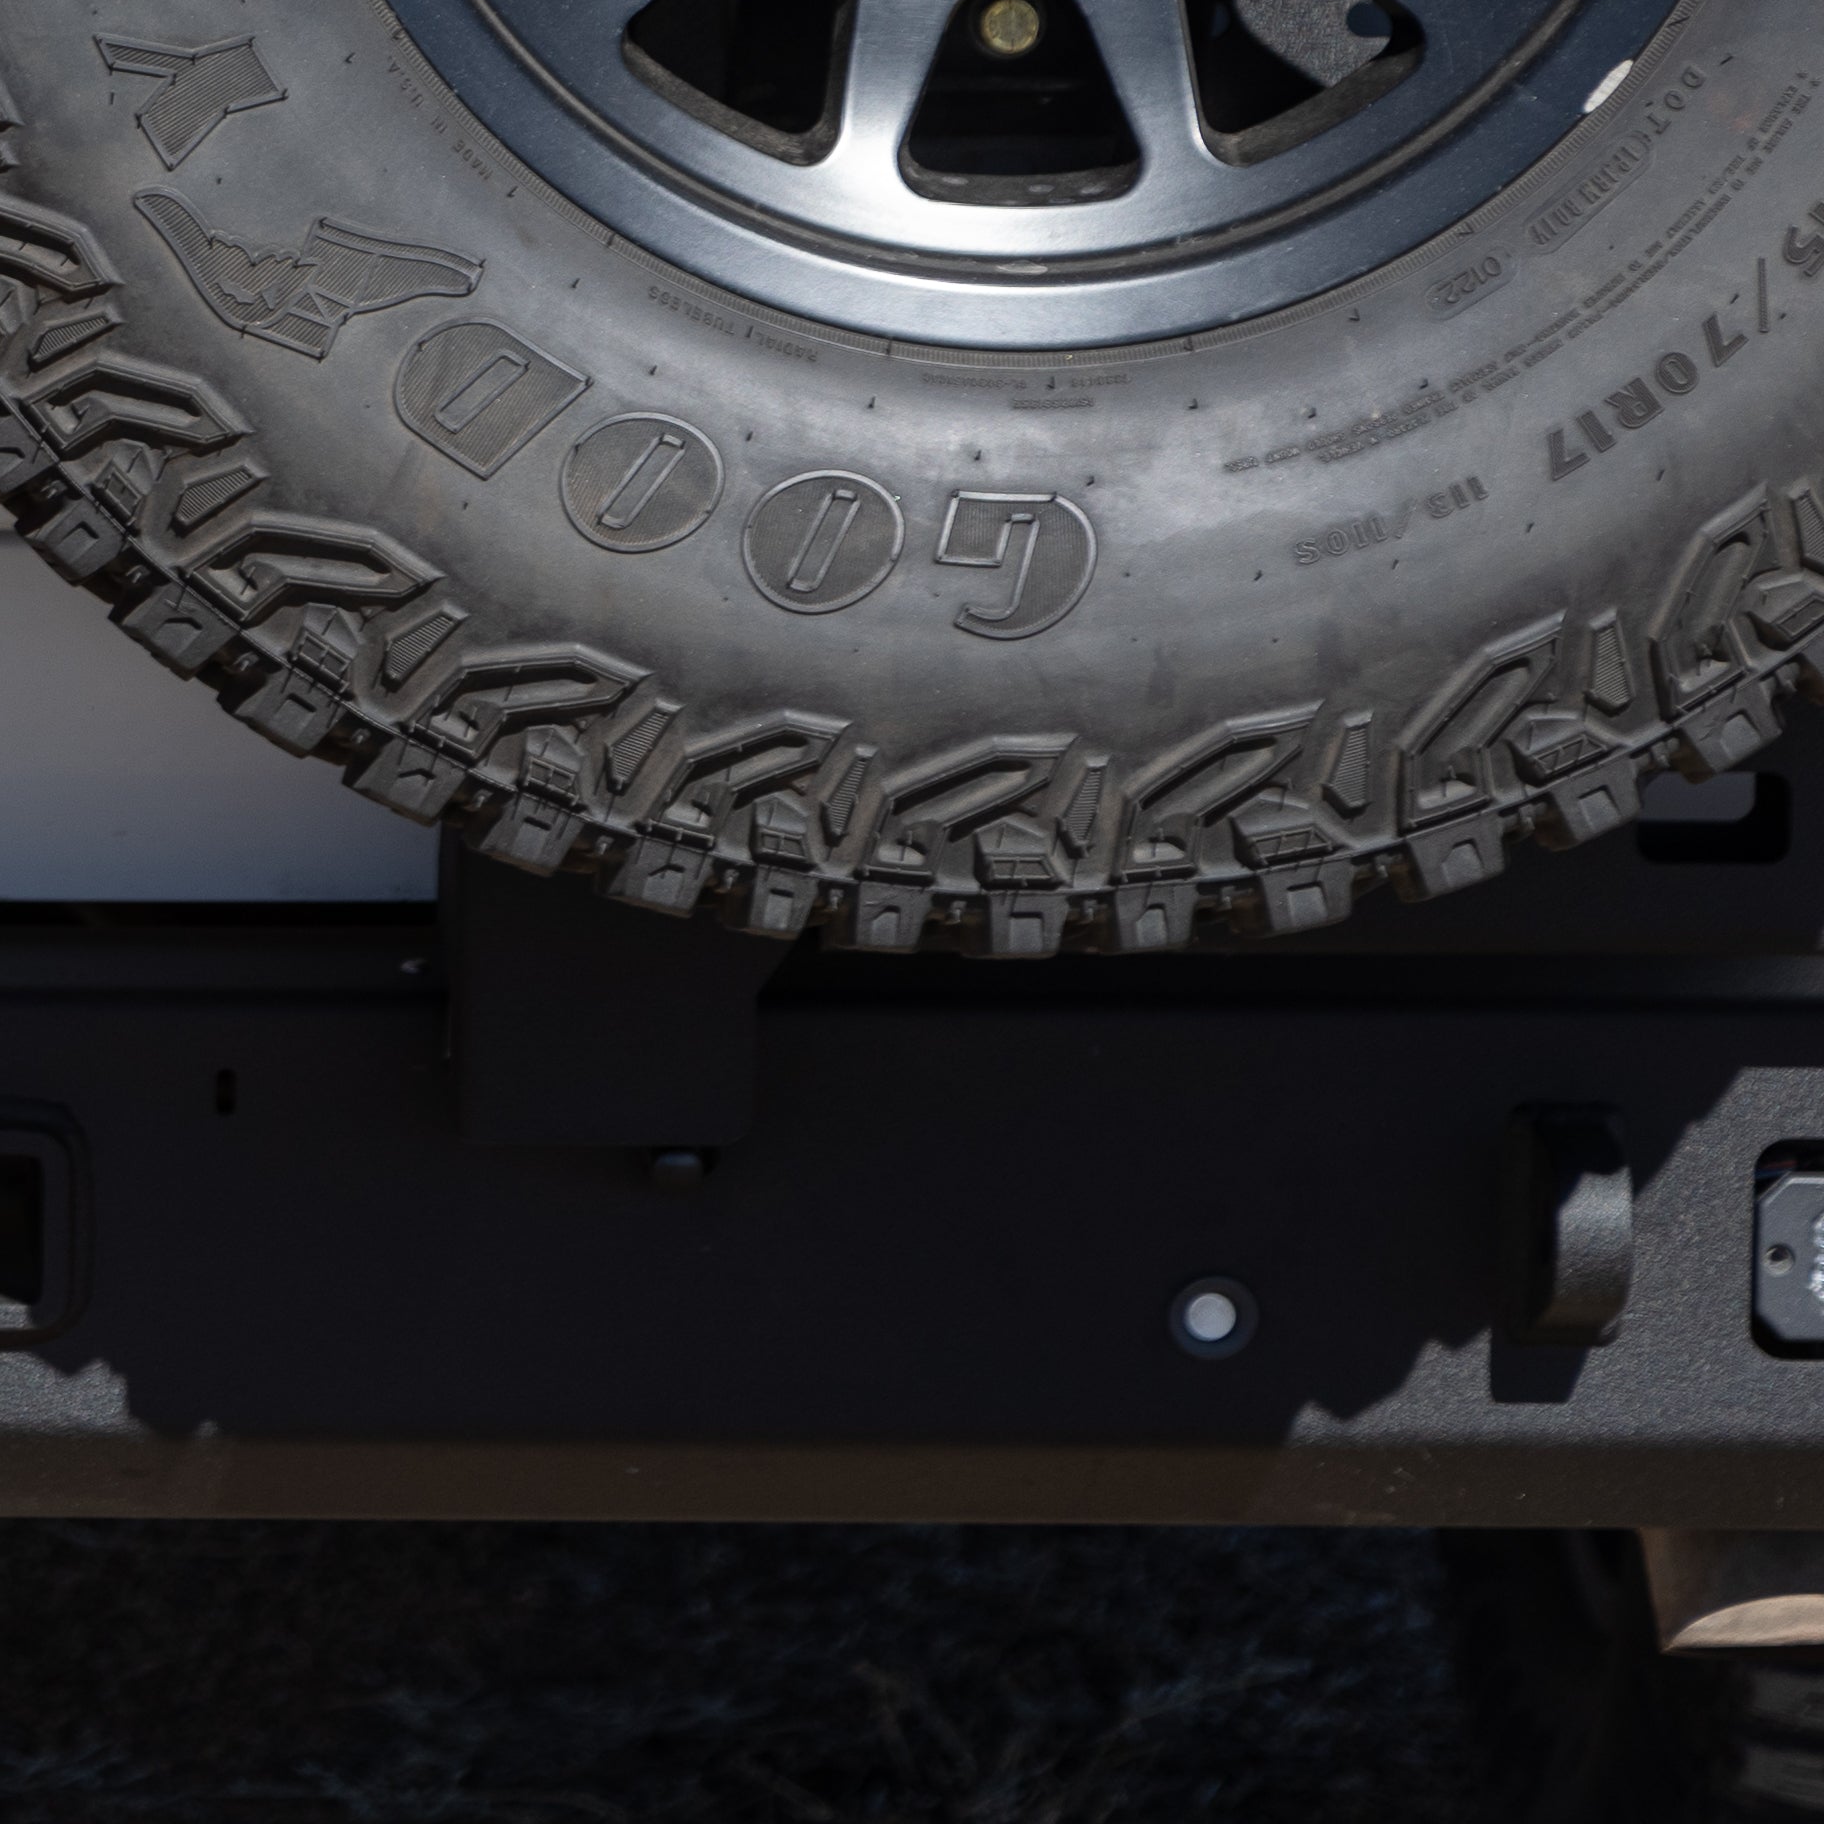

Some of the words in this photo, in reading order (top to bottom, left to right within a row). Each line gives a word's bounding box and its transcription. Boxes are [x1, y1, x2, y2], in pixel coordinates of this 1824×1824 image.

[1645, 64, 1705, 137] DOT
[452, 140, 495, 182] MADE
[1444, 254, 1503, 305] 0122
[1292, 473, 1490, 568] 113/110S
